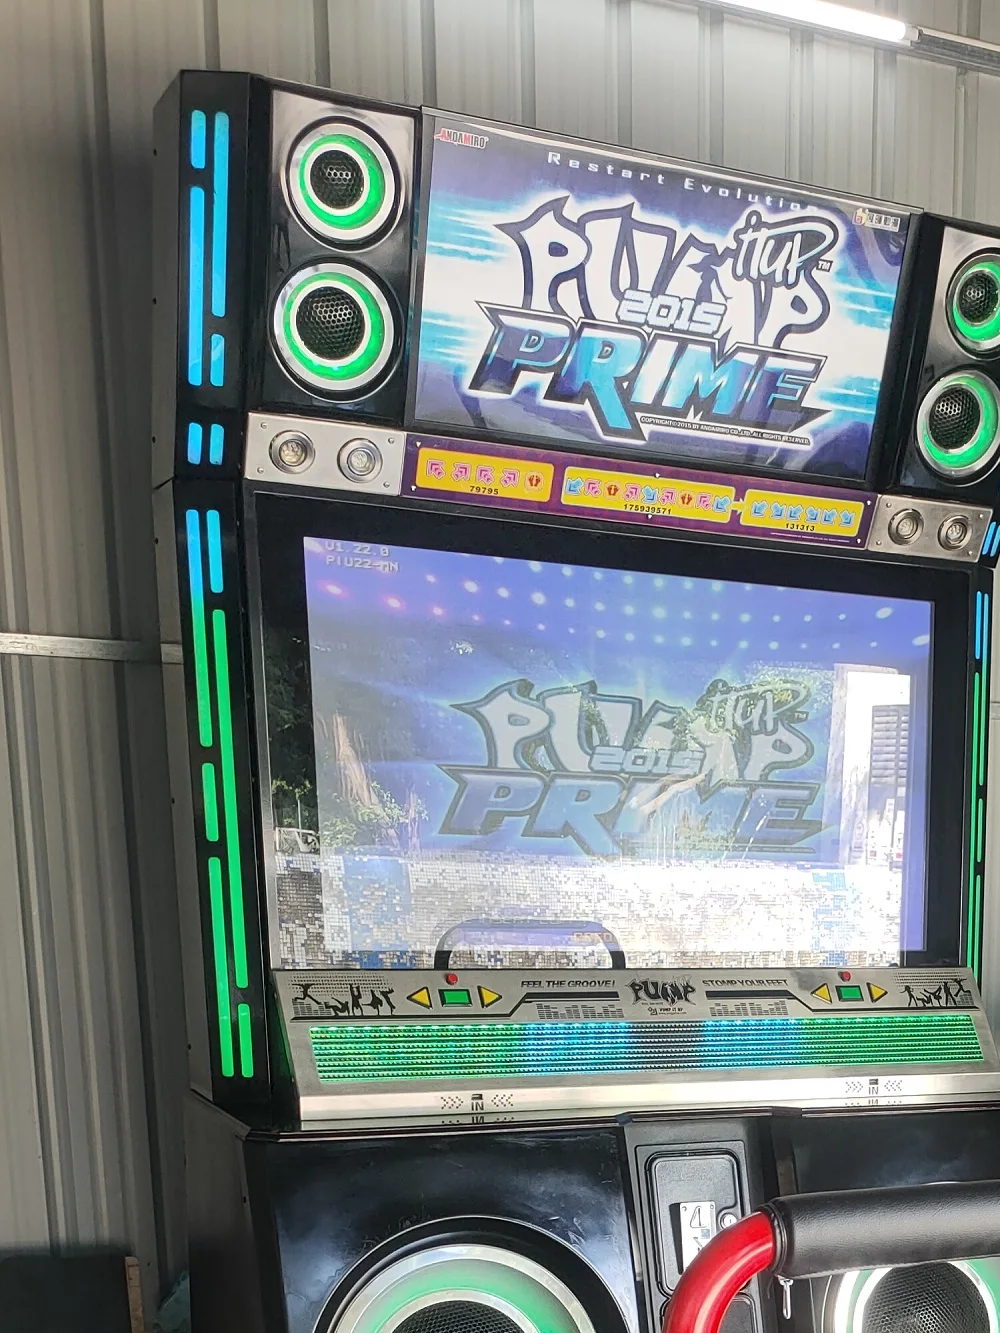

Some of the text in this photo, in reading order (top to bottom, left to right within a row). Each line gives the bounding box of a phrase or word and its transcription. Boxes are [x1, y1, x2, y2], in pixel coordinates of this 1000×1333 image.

[548, 151, 819, 213] Restart Evolution
[617, 289, 727, 335] 2015
[468, 301, 831, 441] PRIME
[470, 486, 499, 495] 79795
[623, 504, 672, 515] 175939571
[785, 523, 815, 531] 131313
[590, 745, 704, 774] 2015
[437, 765, 836, 860] PRIME
[520, 980, 545, 988] FEEL
[625, 977, 696, 1006] PUMP
[868, 1086, 879, 1095] IN
[471, 1102, 484, 1111] IN
